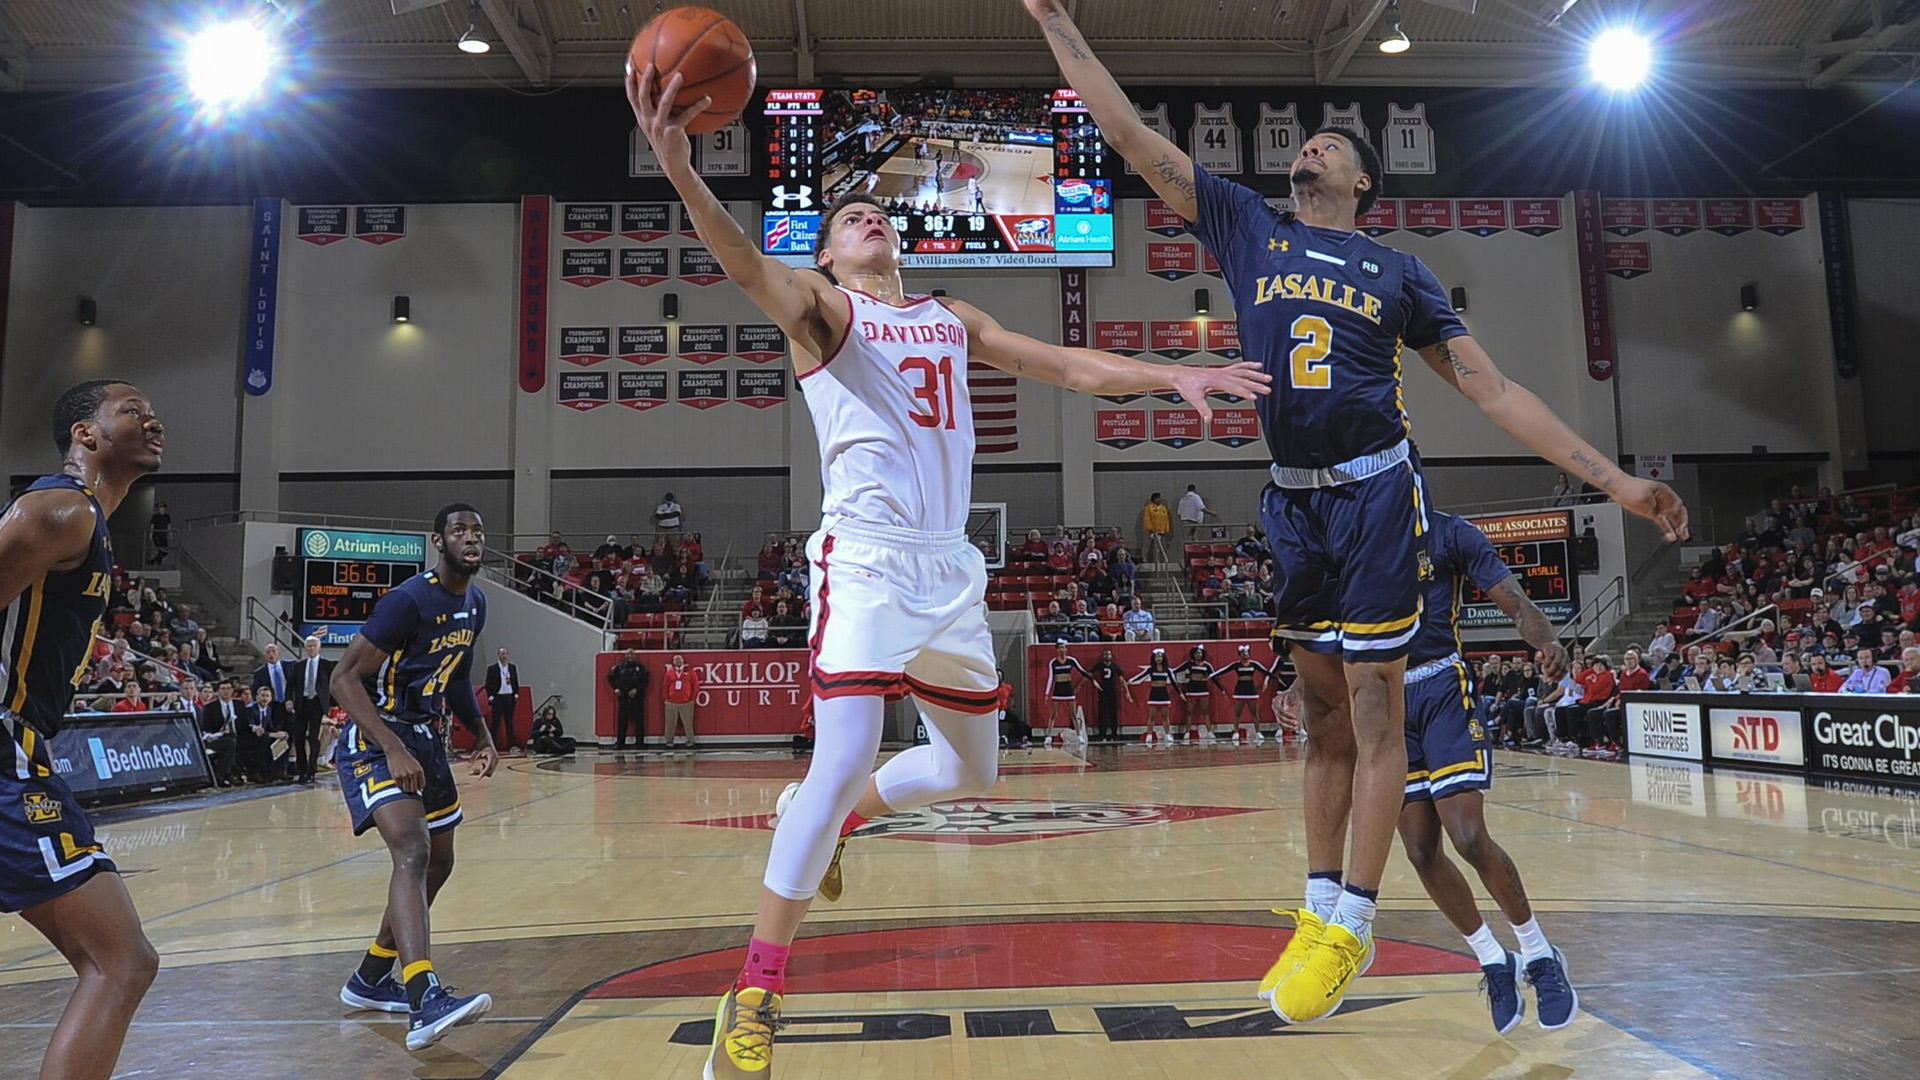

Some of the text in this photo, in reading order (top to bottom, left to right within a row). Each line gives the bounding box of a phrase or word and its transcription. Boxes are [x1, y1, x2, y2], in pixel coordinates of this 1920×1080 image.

[772, 92, 816, 100] TEAM STATS
[1200, 117, 1229, 126] HETZEL
[1264, 116, 1294, 126] SNYDER
[1331, 116, 1355, 125] GERDY
[1393, 117, 1422, 126] RUCKER
[713, 130, 734, 151] 31
[1204, 128, 1227, 149] 44
[1269, 128, 1290, 149] 10
[1400, 128, 1416, 149] 11
[568, 213, 609, 221] CHAMPIONS
[625, 212, 666, 221] CHAMPIONS
[1410, 208, 1446, 216] POSTSEASON
[1462, 209, 1502, 217] TOURNAMENT
[790, 220, 808, 230] First
[924, 216, 954, 232] 36.7
[968, 216, 985, 231] 19
[1583, 198, 1594, 252] SAINT
[790, 231, 818, 240] Citizen
[1058, 234, 1111, 244] Atrium Health
[790, 241, 810, 251] Bank
[566, 257, 608, 265] CHAMPIONS
[623, 257, 665, 265] CHAMPIONS
[916, 255, 976, 265] Williamson
[978, 255, 991, 264] '67
[995, 255, 1026, 265] Video
[1027, 254, 1058, 264] Board
[1362, 260, 1379, 274] RB
[255, 211, 272, 350] SAINT LOUIS
[526, 210, 540, 353] RICHMOND
[1254, 273, 1382, 326] LASALLE
[564, 335, 606, 344] CHAMPIONS
[622, 335, 664, 343] CHAMPIONS
[682, 334, 724, 342] CHAMPIONS
[739, 333, 781, 342] CHAMPIONS
[861, 321, 966, 349] DAVIDSON
[634, 344, 652, 352] 2007
[1290, 314, 1334, 389] 2
[563, 381, 605, 390] CHAMPIONS
[622, 380, 663, 389] CHAMPIONS
[682, 379, 724, 387] CHAMPIONS
[740, 378, 782, 386] CHAMPIONS
[634, 389, 651, 397] 2015
[694, 388, 711, 396] 2013
[752, 387, 769, 395] 2012
[898, 356, 956, 430] 31
[1169, 427, 1186, 435] 2012
[1503, 517, 1567, 532] ASSOCIATES
[1527, 528, 1565, 536] MANAGEMENT
[334, 538, 422, 556] Atrium Health
[1527, 565, 1560, 577] LASALLE
[310, 585, 348, 596] DAVIDSON
[1548, 577, 1565, 595] 19
[352, 591, 373, 599] PERIOD
[422, 650, 464, 696] 24
[1729, 716, 1780, 752] ATD
[1813, 711, 1874, 747] Great
[1644, 734, 1690, 752] ENTERPRISES
[106, 744, 192, 774] BedInABox
[1822, 753, 1839, 769] IT'S
[1840, 755, 1874, 772] GONNA
[1875, 758, 1890, 774] BE
